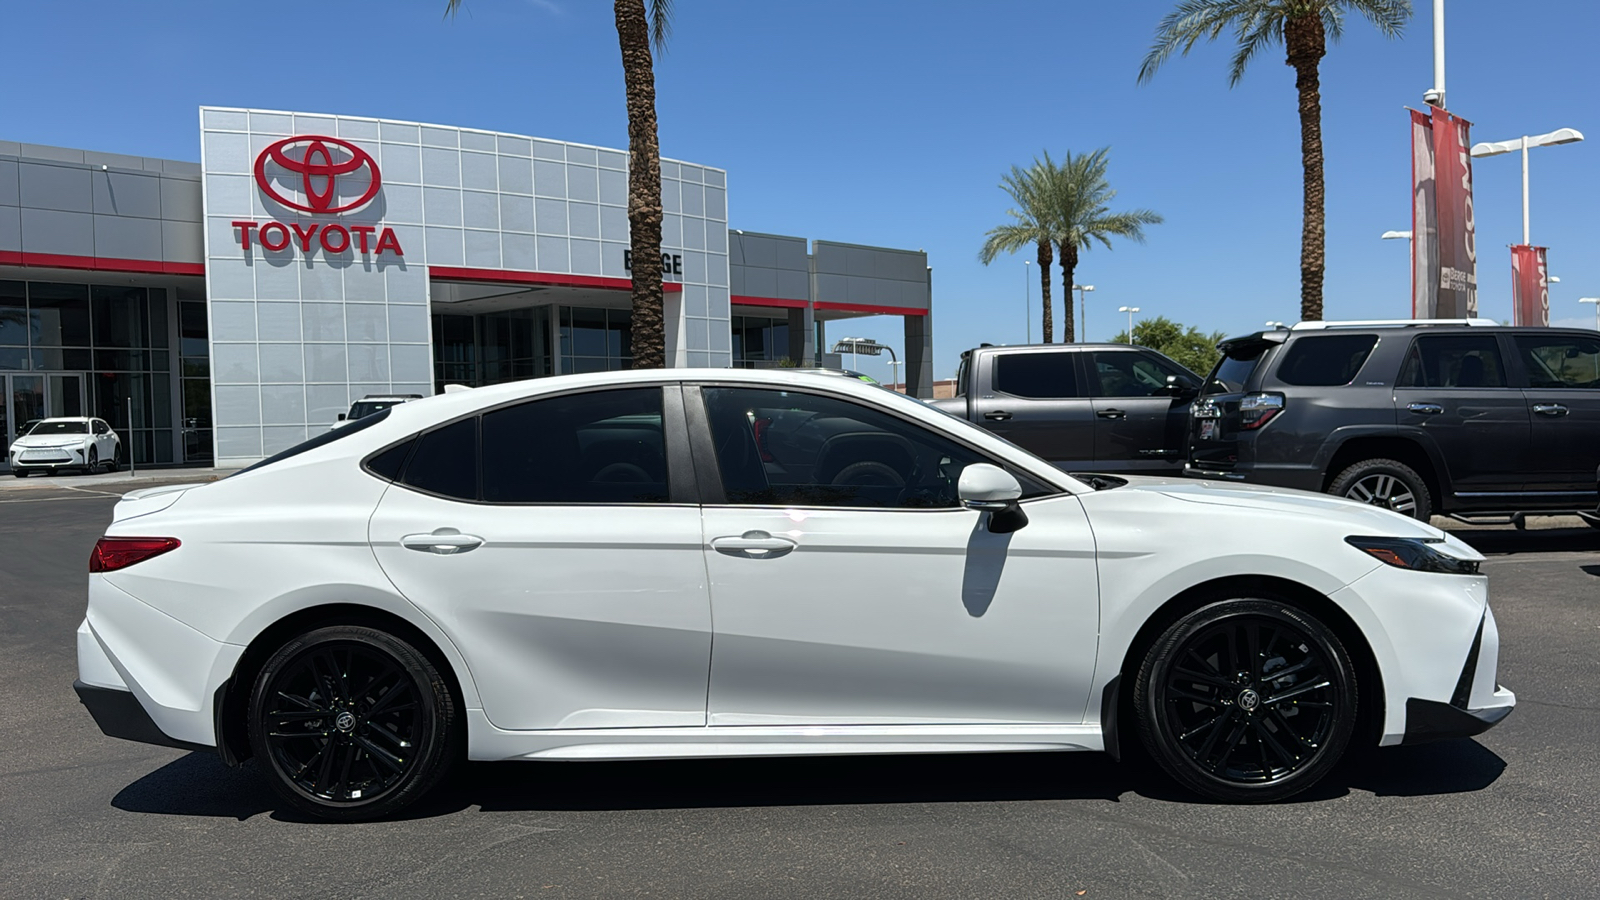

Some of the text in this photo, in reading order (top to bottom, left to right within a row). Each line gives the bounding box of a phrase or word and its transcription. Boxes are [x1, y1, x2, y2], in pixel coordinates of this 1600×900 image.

[1457, 123, 1478, 318] ELCOME
[231, 221, 404, 256] TOYOTA
[624, 249, 682, 275] BGE
